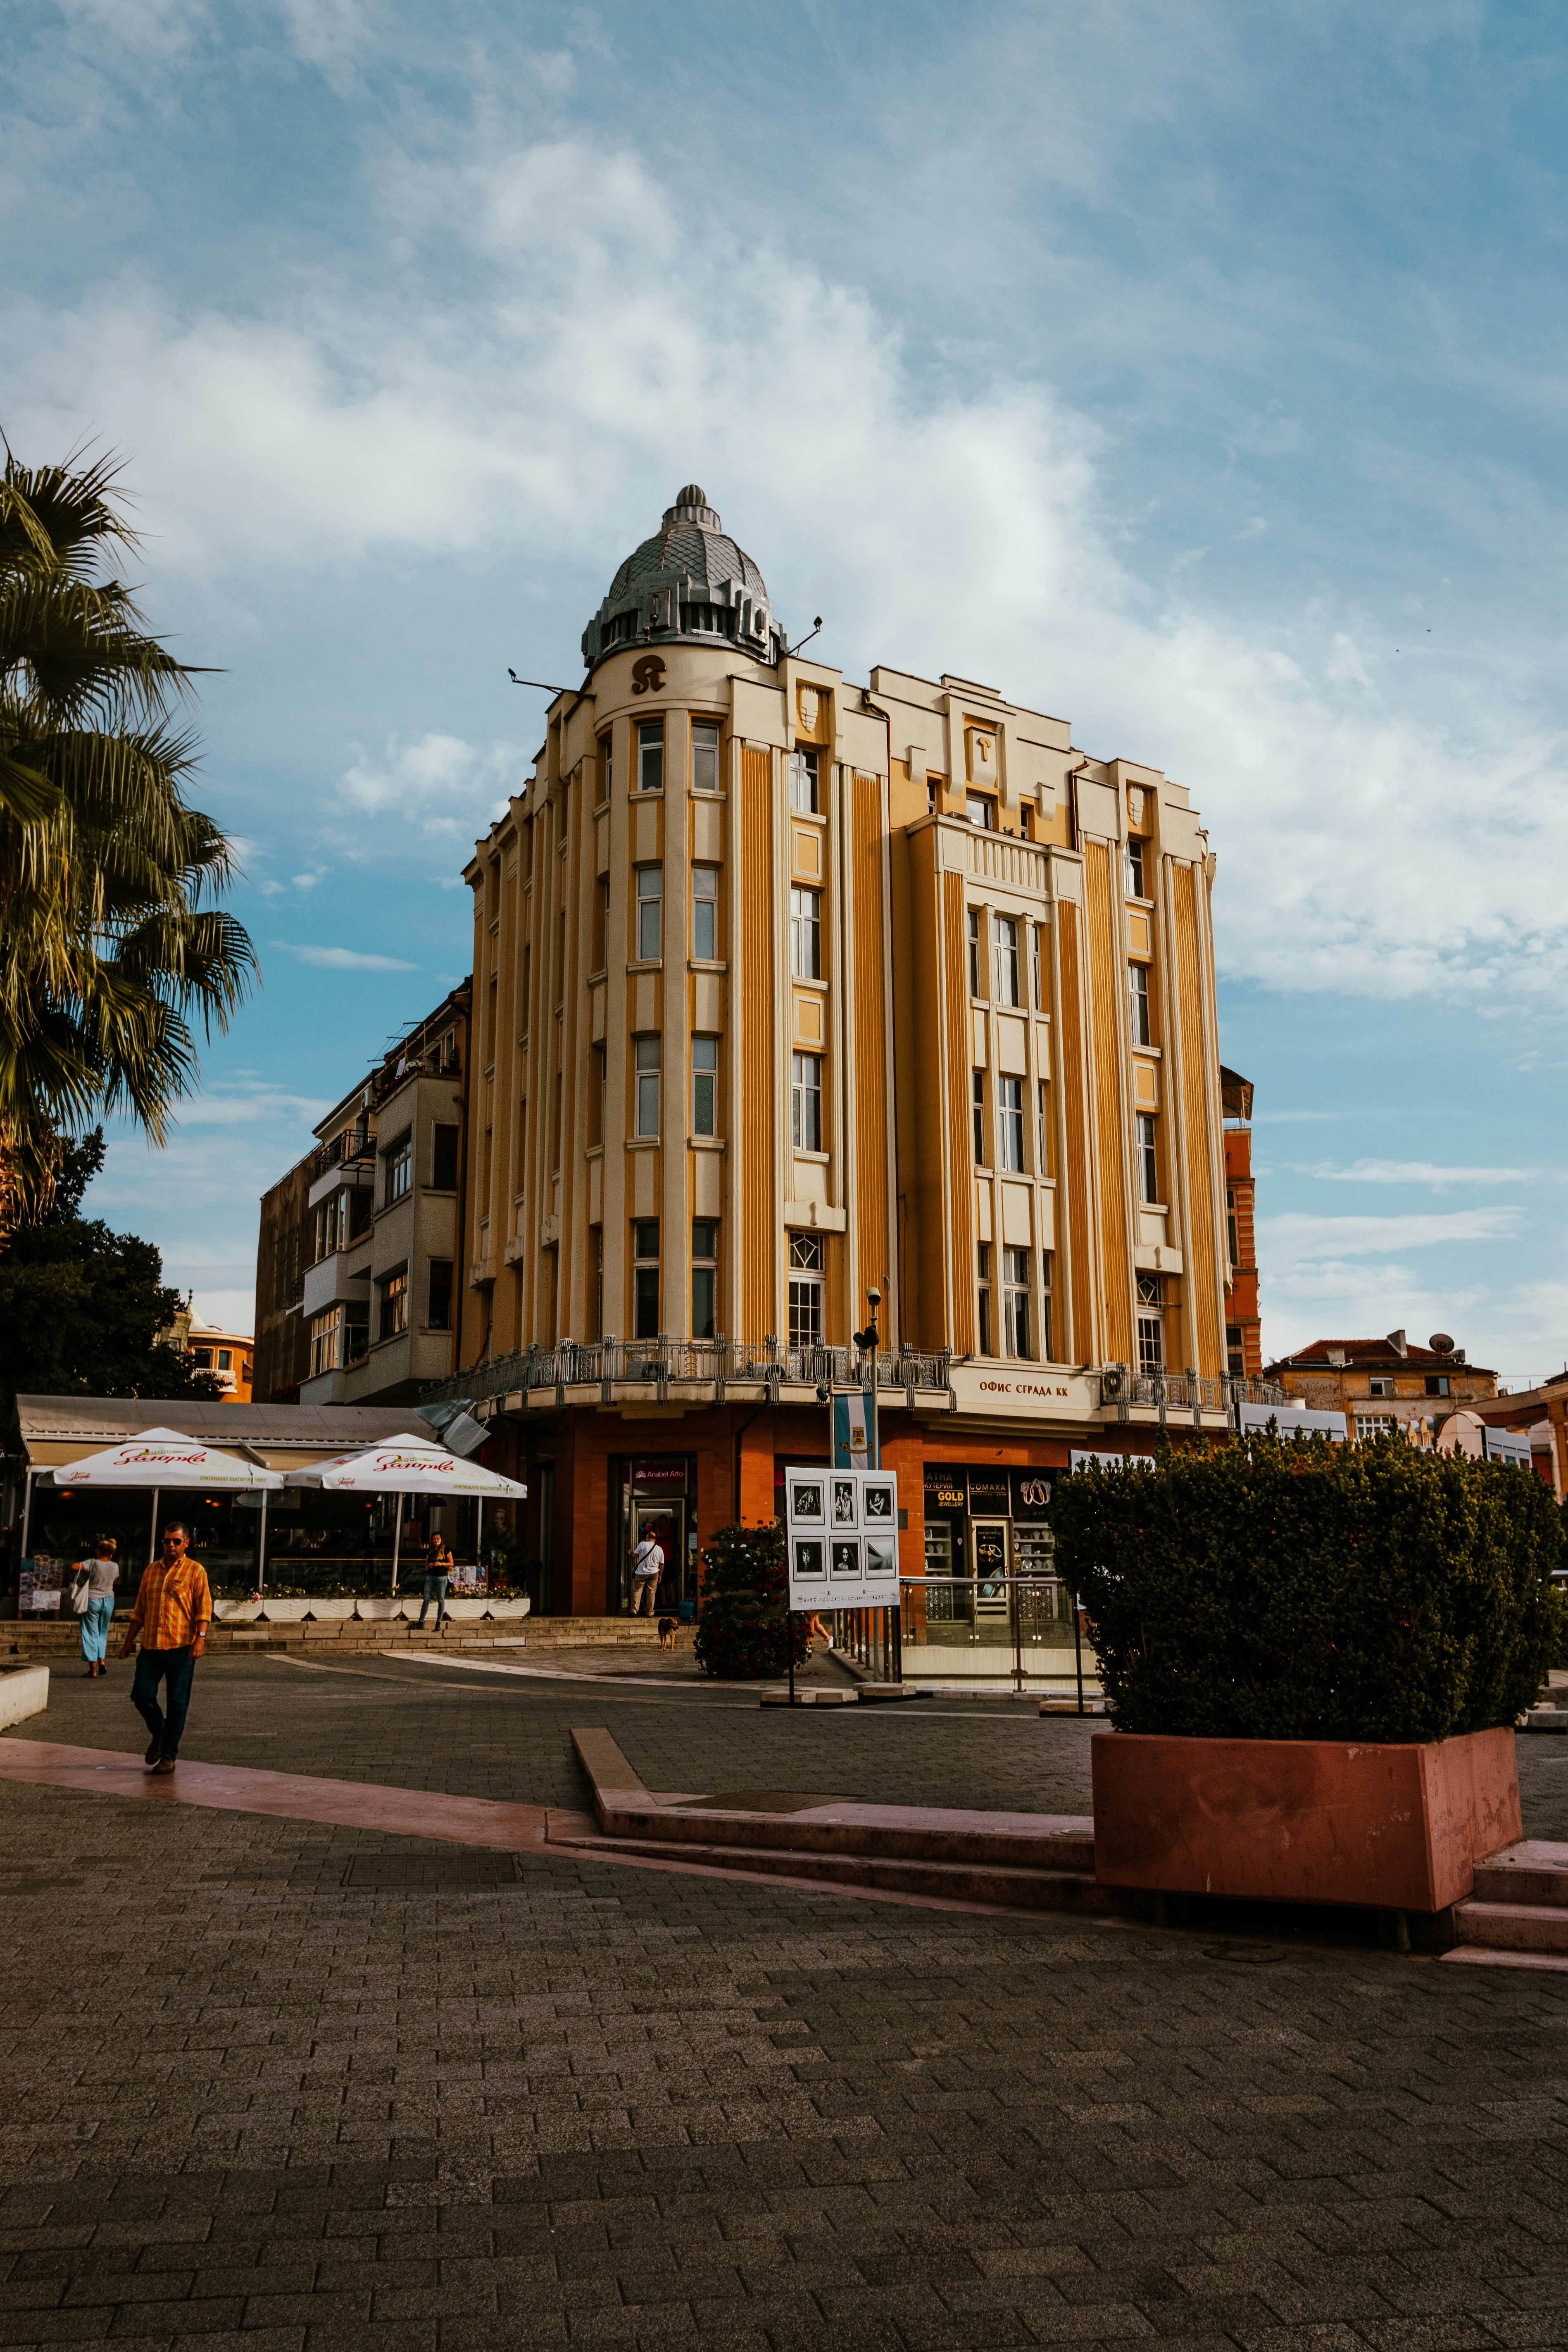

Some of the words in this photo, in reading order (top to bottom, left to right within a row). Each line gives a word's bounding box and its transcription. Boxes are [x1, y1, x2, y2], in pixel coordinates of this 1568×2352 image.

[980, 1381, 1011, 1392] ОФИС
[1016, 1385, 1052, 1397] СГРАДА
[1056, 1388, 1068, 1396] КК
[114, 1448, 207, 1465] Загорка
[374, 1455, 455, 1474] Загорка
[938, 1492, 964, 1501] GOLD
